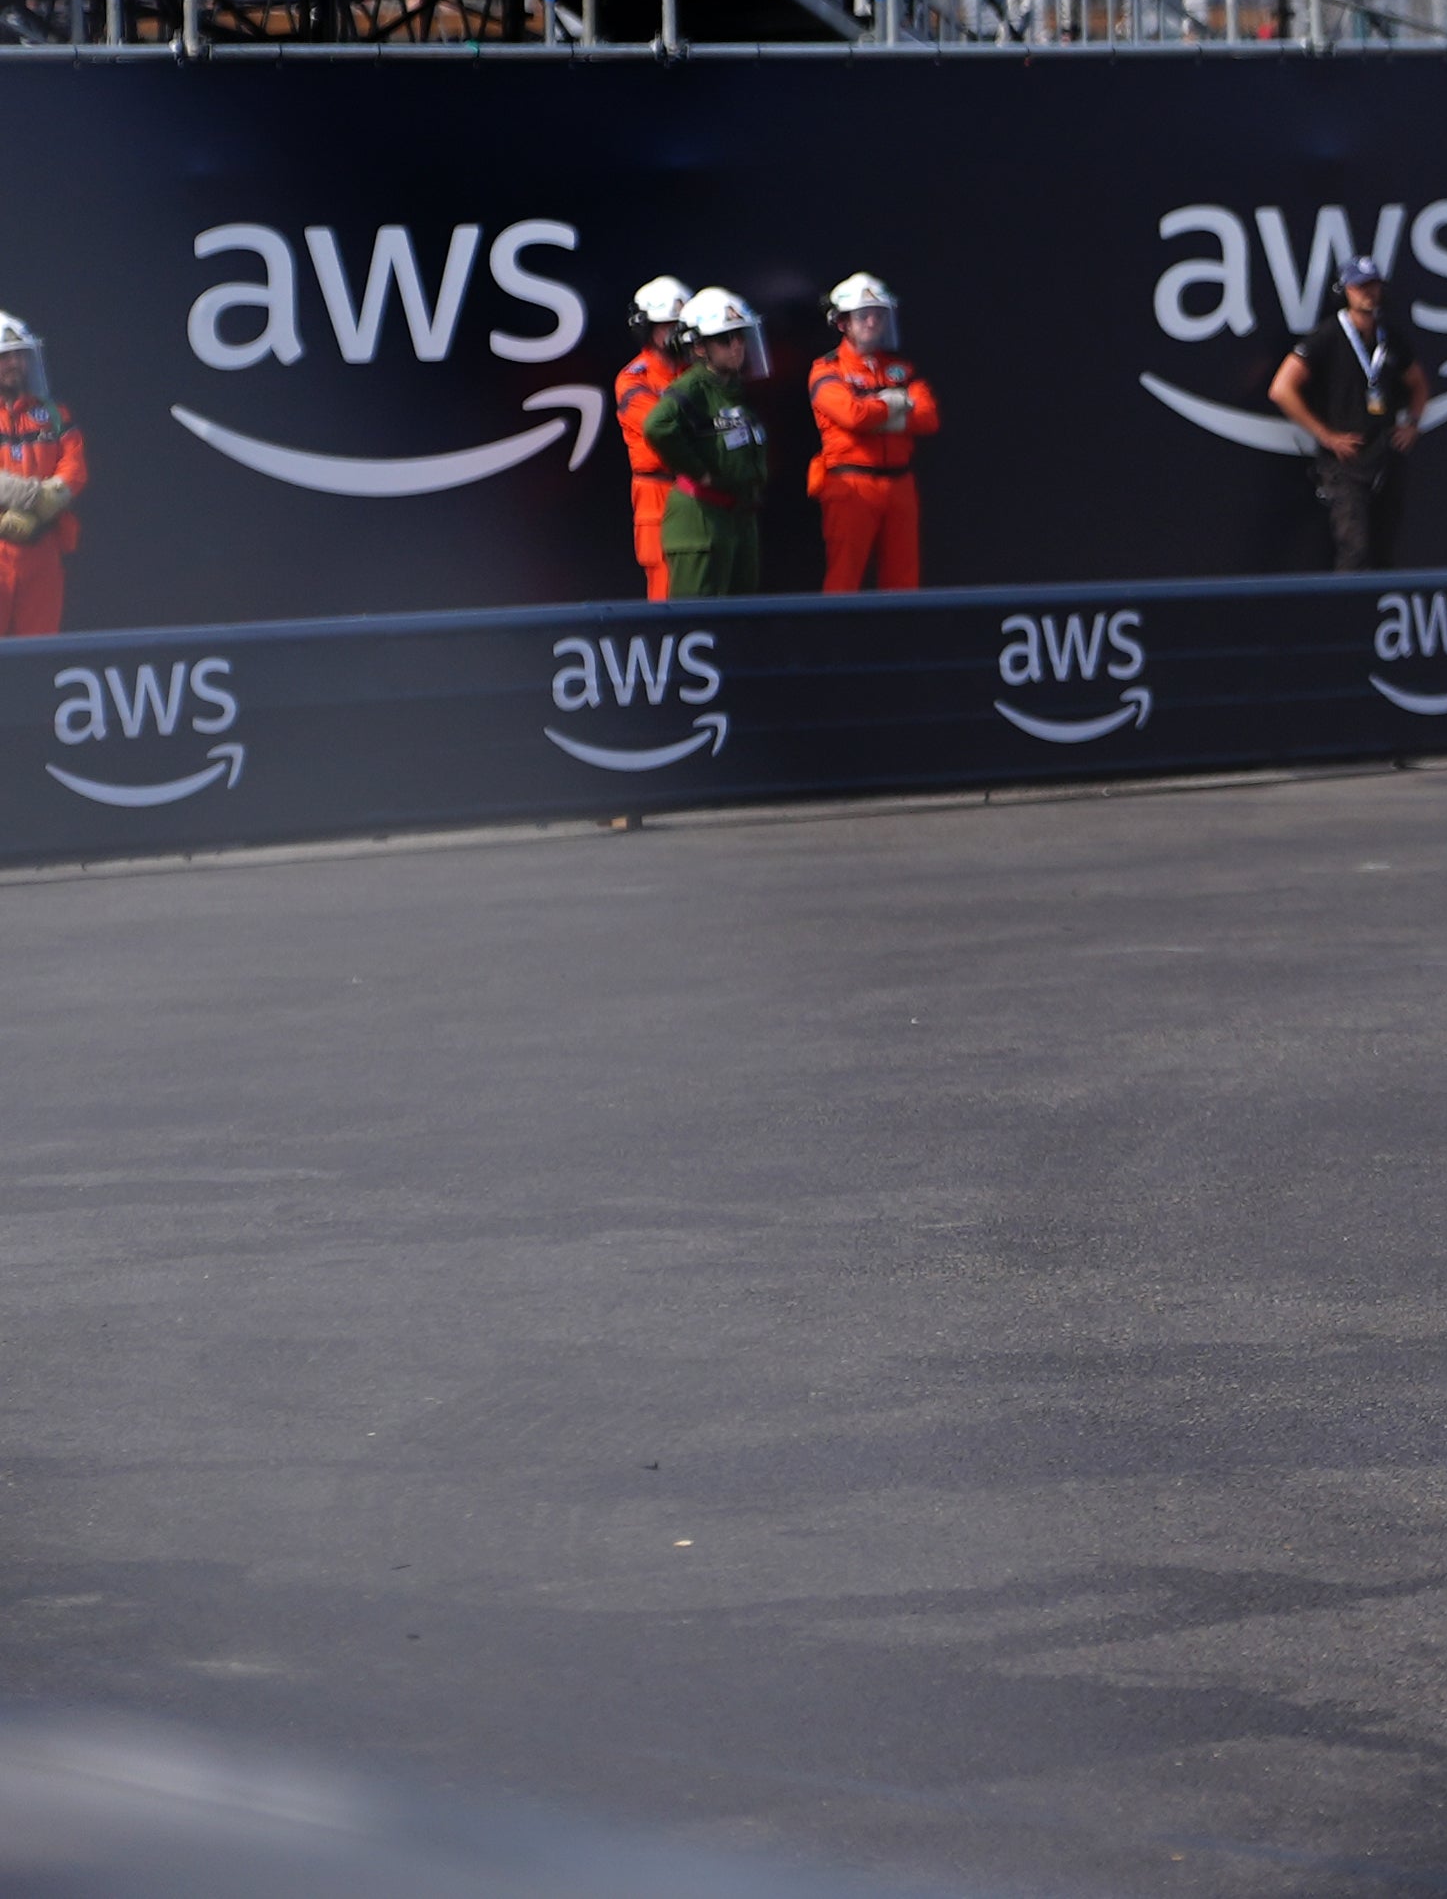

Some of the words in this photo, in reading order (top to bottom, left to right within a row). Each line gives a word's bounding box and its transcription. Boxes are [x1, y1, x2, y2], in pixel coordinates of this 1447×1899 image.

[188, 219, 586, 371] aws
[552, 632, 721, 711] aws
[999, 610, 1145, 686] aws
[54, 658, 238, 744] aws
